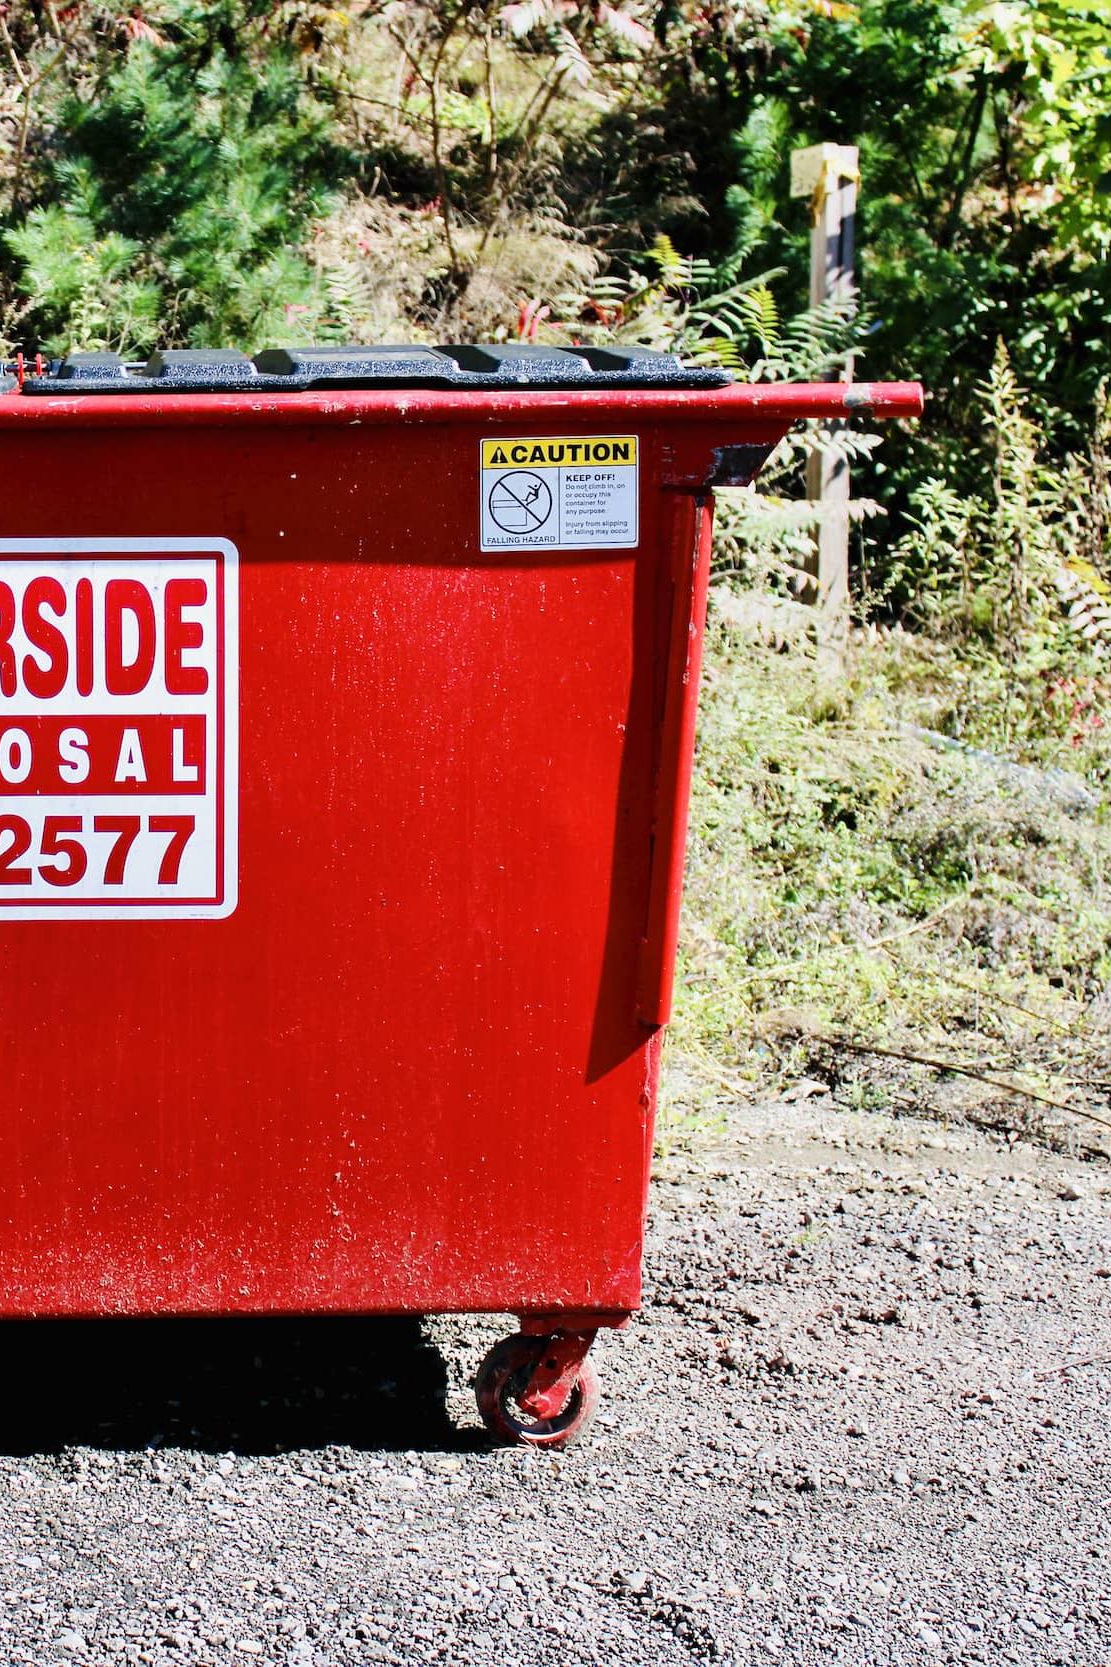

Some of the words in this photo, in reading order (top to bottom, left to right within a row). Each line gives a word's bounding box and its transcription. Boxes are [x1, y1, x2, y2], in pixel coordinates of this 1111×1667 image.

[510, 443, 630, 463] CAUTION
[565, 474, 591, 482] KEEP
[594, 473, 615, 481] OFF!
[588, 482, 606, 490] climb
[565, 521, 585, 529] Injury
[602, 520, 628, 528] slipping
[487, 536, 521, 544] FALLING
[522, 535, 556, 543] HAZARD
